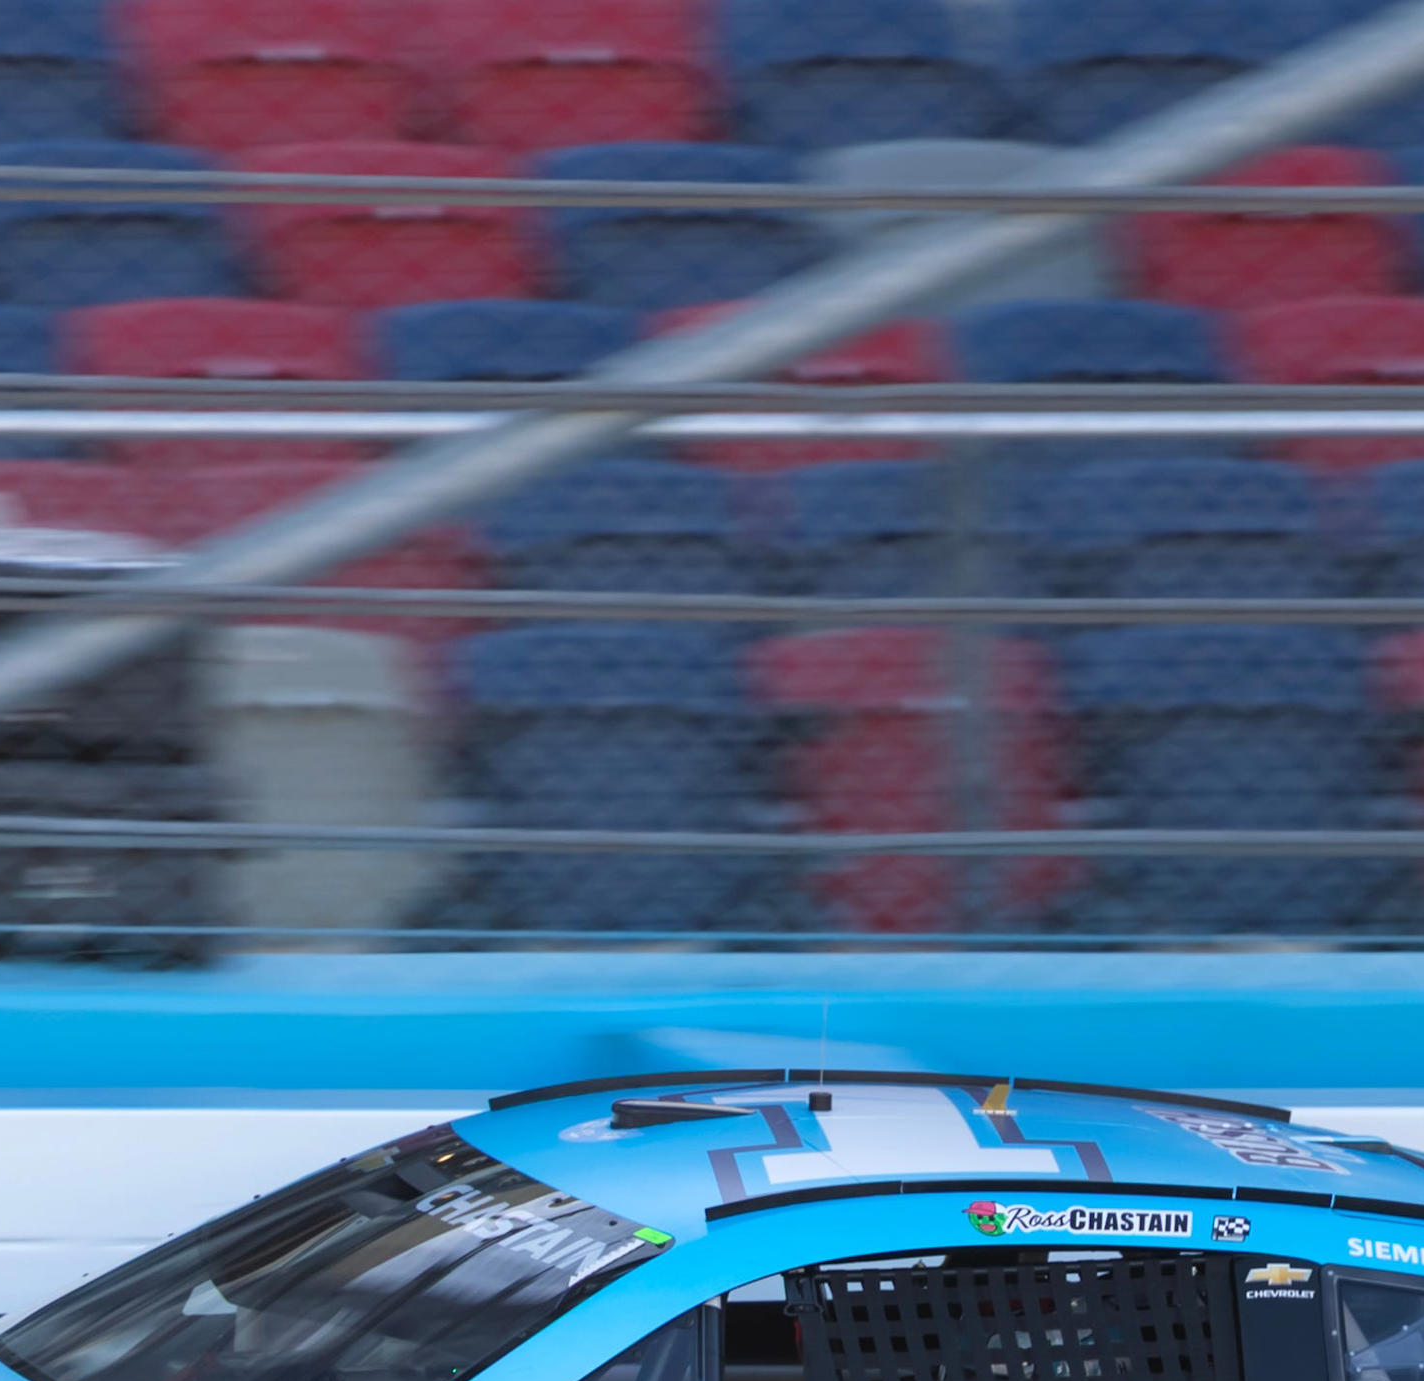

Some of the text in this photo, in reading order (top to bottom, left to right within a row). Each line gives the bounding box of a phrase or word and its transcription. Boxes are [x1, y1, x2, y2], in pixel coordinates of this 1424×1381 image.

[692, 1083, 1092, 1197] 1
[1006, 1206, 1189, 1233] Ross CHASTAIN
[1246, 1289, 1315, 1300] CHEVROLET
